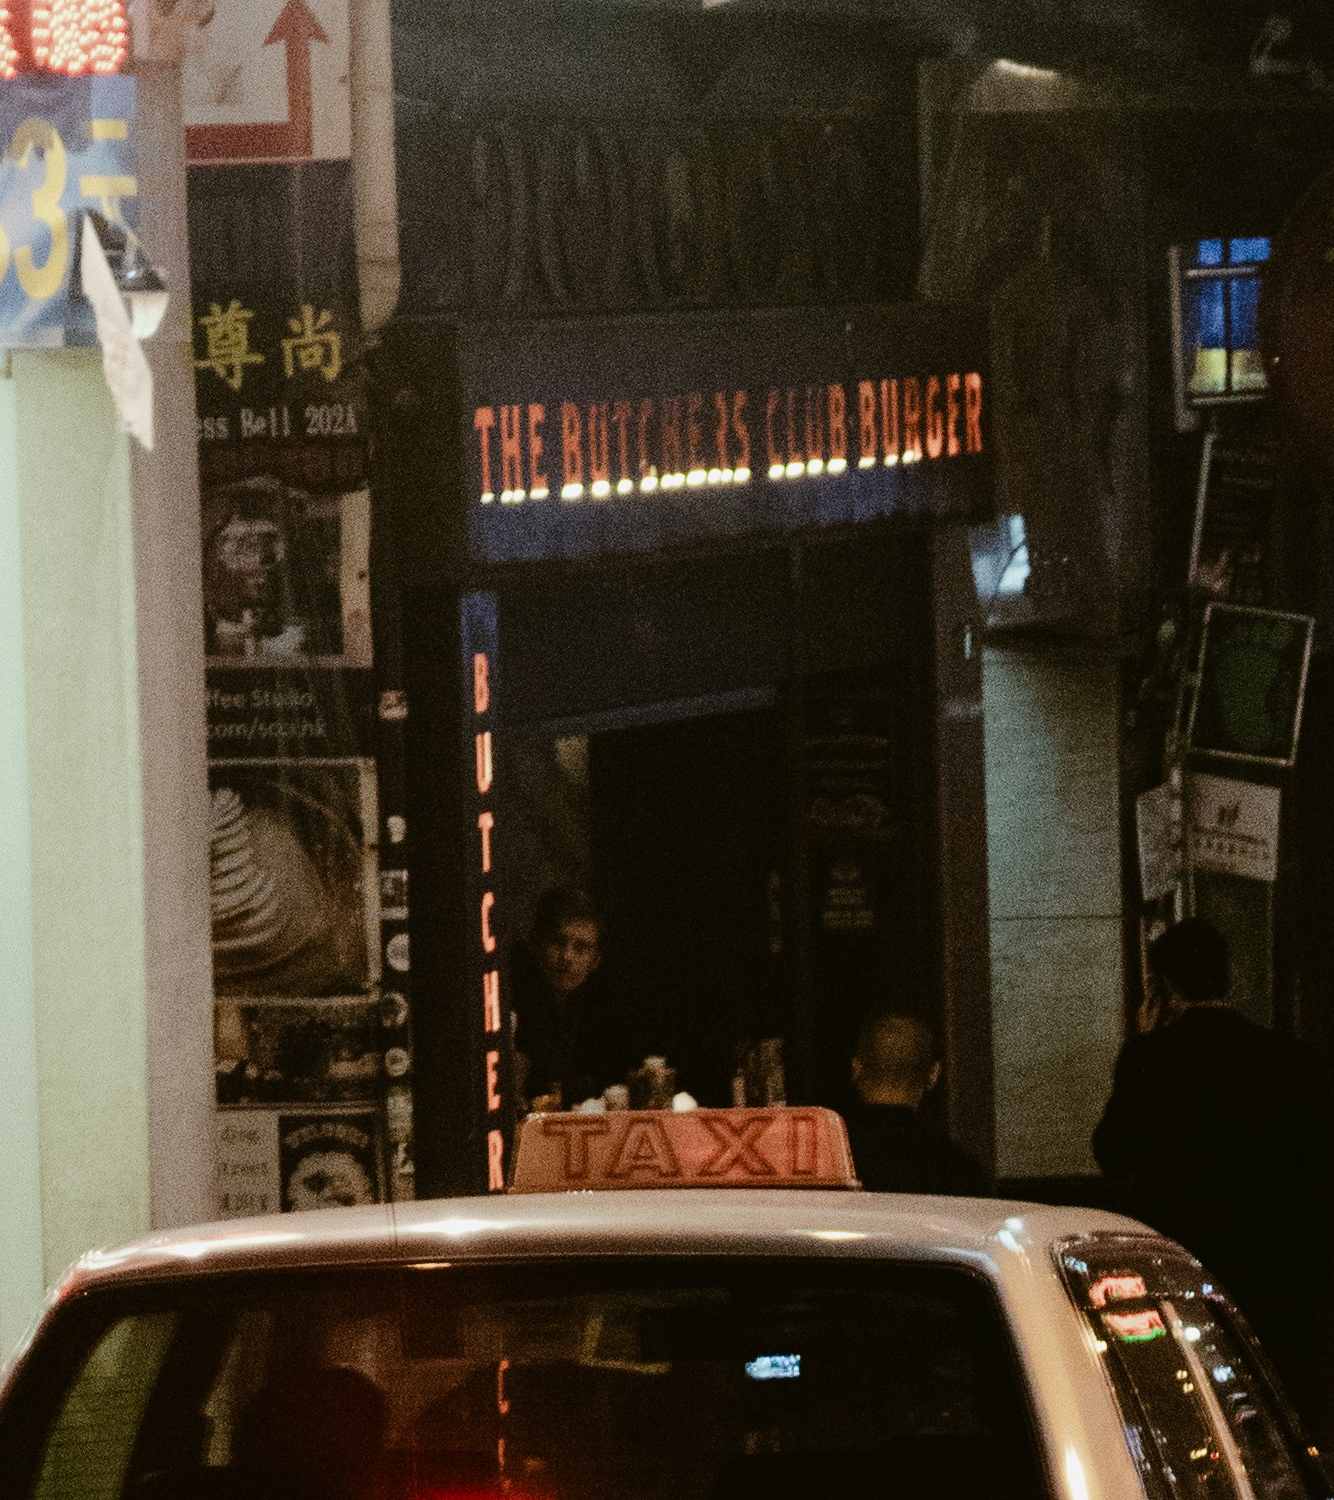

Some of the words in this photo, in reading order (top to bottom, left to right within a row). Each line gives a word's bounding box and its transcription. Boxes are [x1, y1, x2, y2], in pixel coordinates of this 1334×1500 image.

[473, 402, 550, 505] THE
[559, 388, 752, 500] BUTCHERS
[766, 383, 848, 480] CLUB
[856, 370, 984, 472] BURGER
[542, 1114, 819, 1181] TAXI
